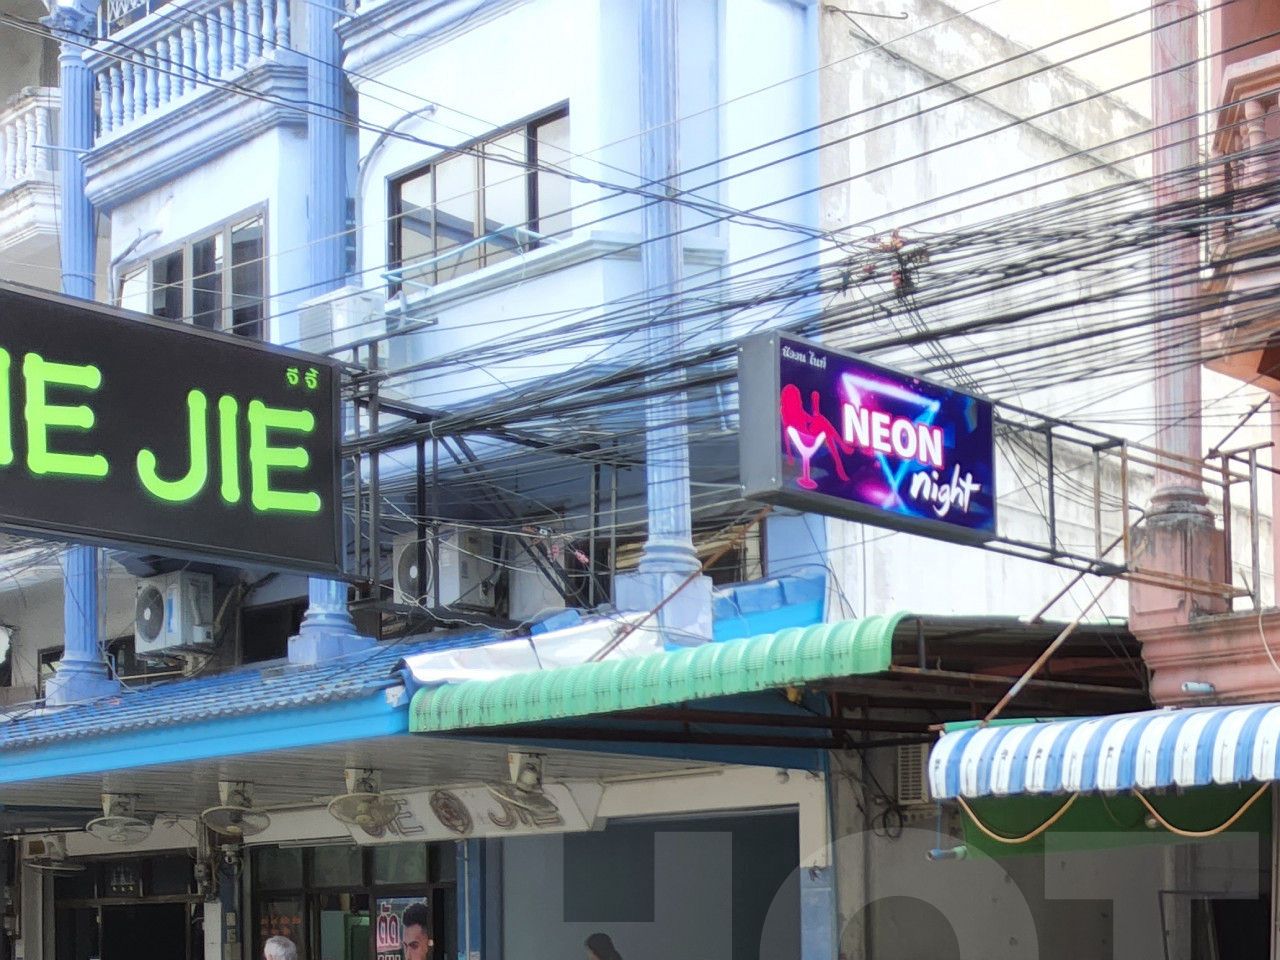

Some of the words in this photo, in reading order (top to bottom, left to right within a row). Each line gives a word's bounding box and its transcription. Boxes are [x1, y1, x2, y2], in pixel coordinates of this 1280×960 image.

[137, 390, 321, 511] JIE
[843, 403, 943, 468] NEON
[909, 463, 981, 517] night
[377, 901, 401, 947] ตัด
